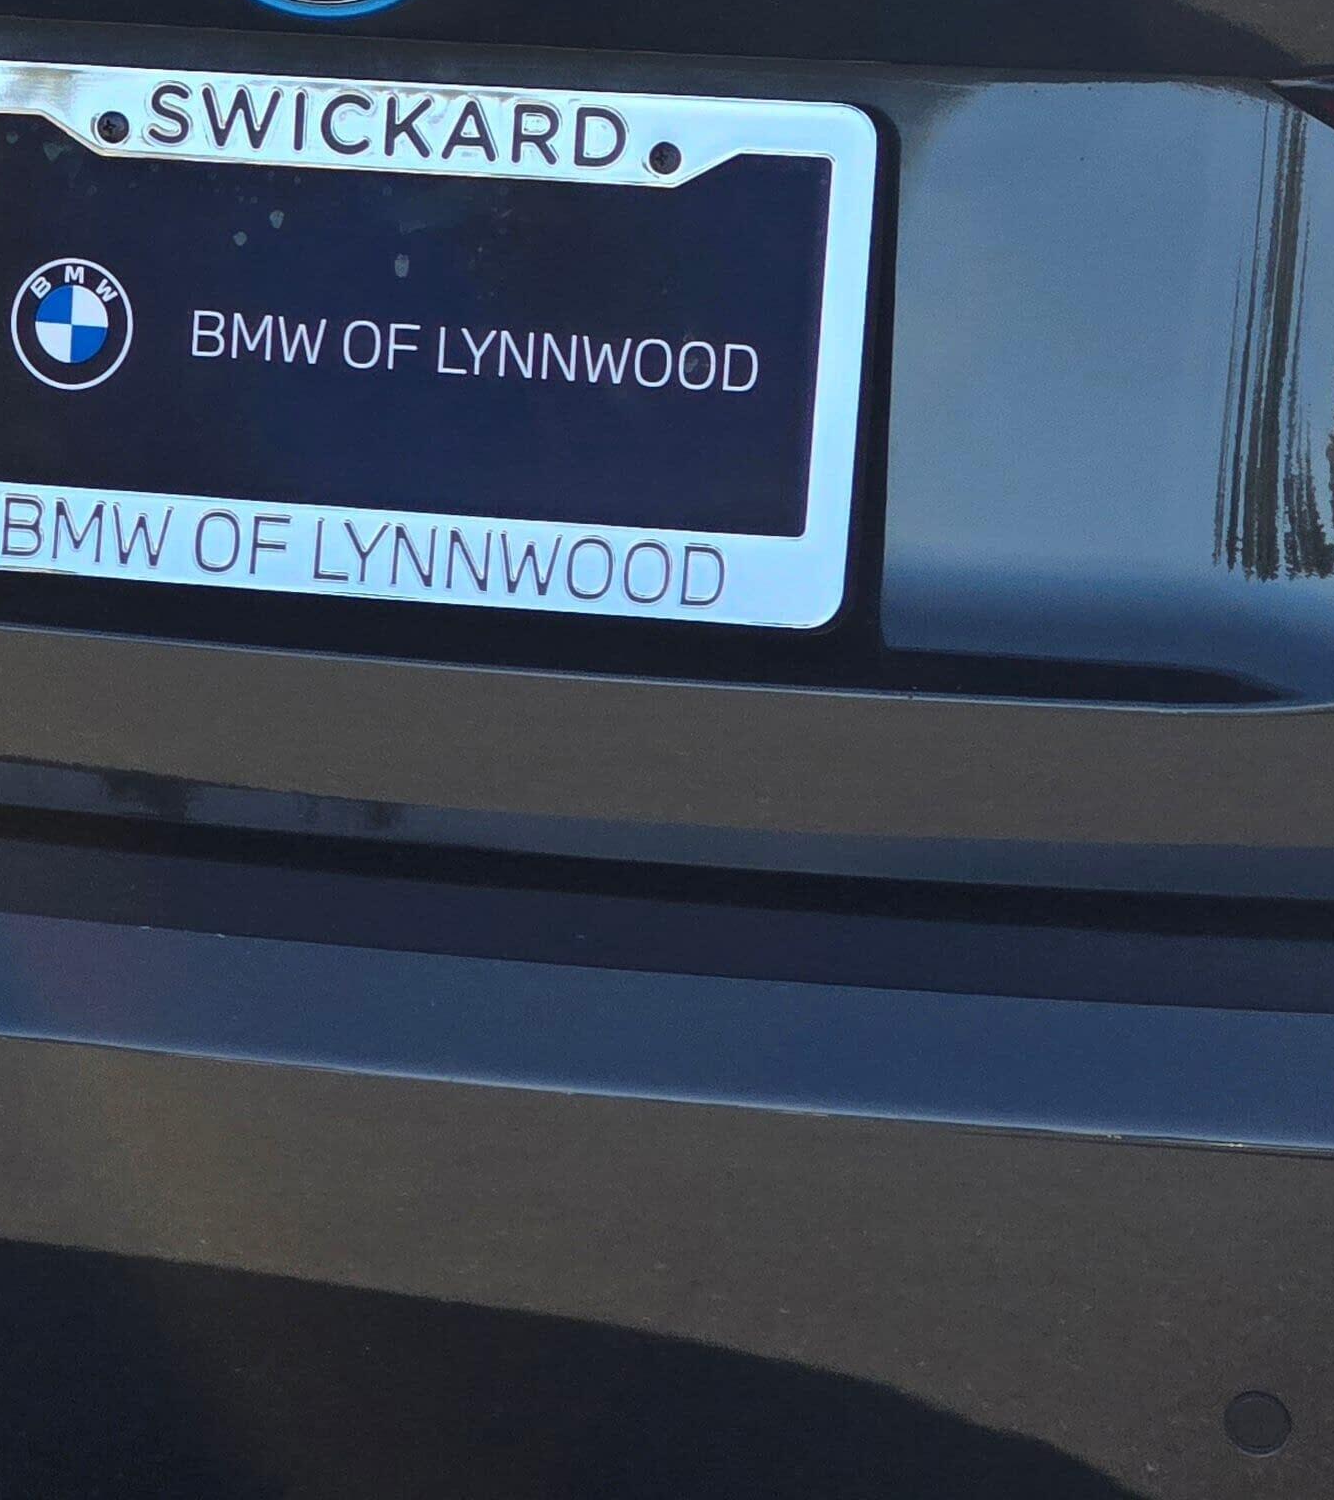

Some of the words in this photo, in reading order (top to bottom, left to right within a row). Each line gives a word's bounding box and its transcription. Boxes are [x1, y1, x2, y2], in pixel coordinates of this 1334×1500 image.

[147, 81, 629, 169] SWICKARD
[30, 265, 118, 303] BMW
[190, 309, 327, 366] BMW
[342, 320, 420, 371] OF
[437, 326, 759, 393] LYNNWOOD
[0, 494, 173, 568] BMW
[194, 508, 290, 578] OF
[313, 517, 727, 608] LYNNWOOD
